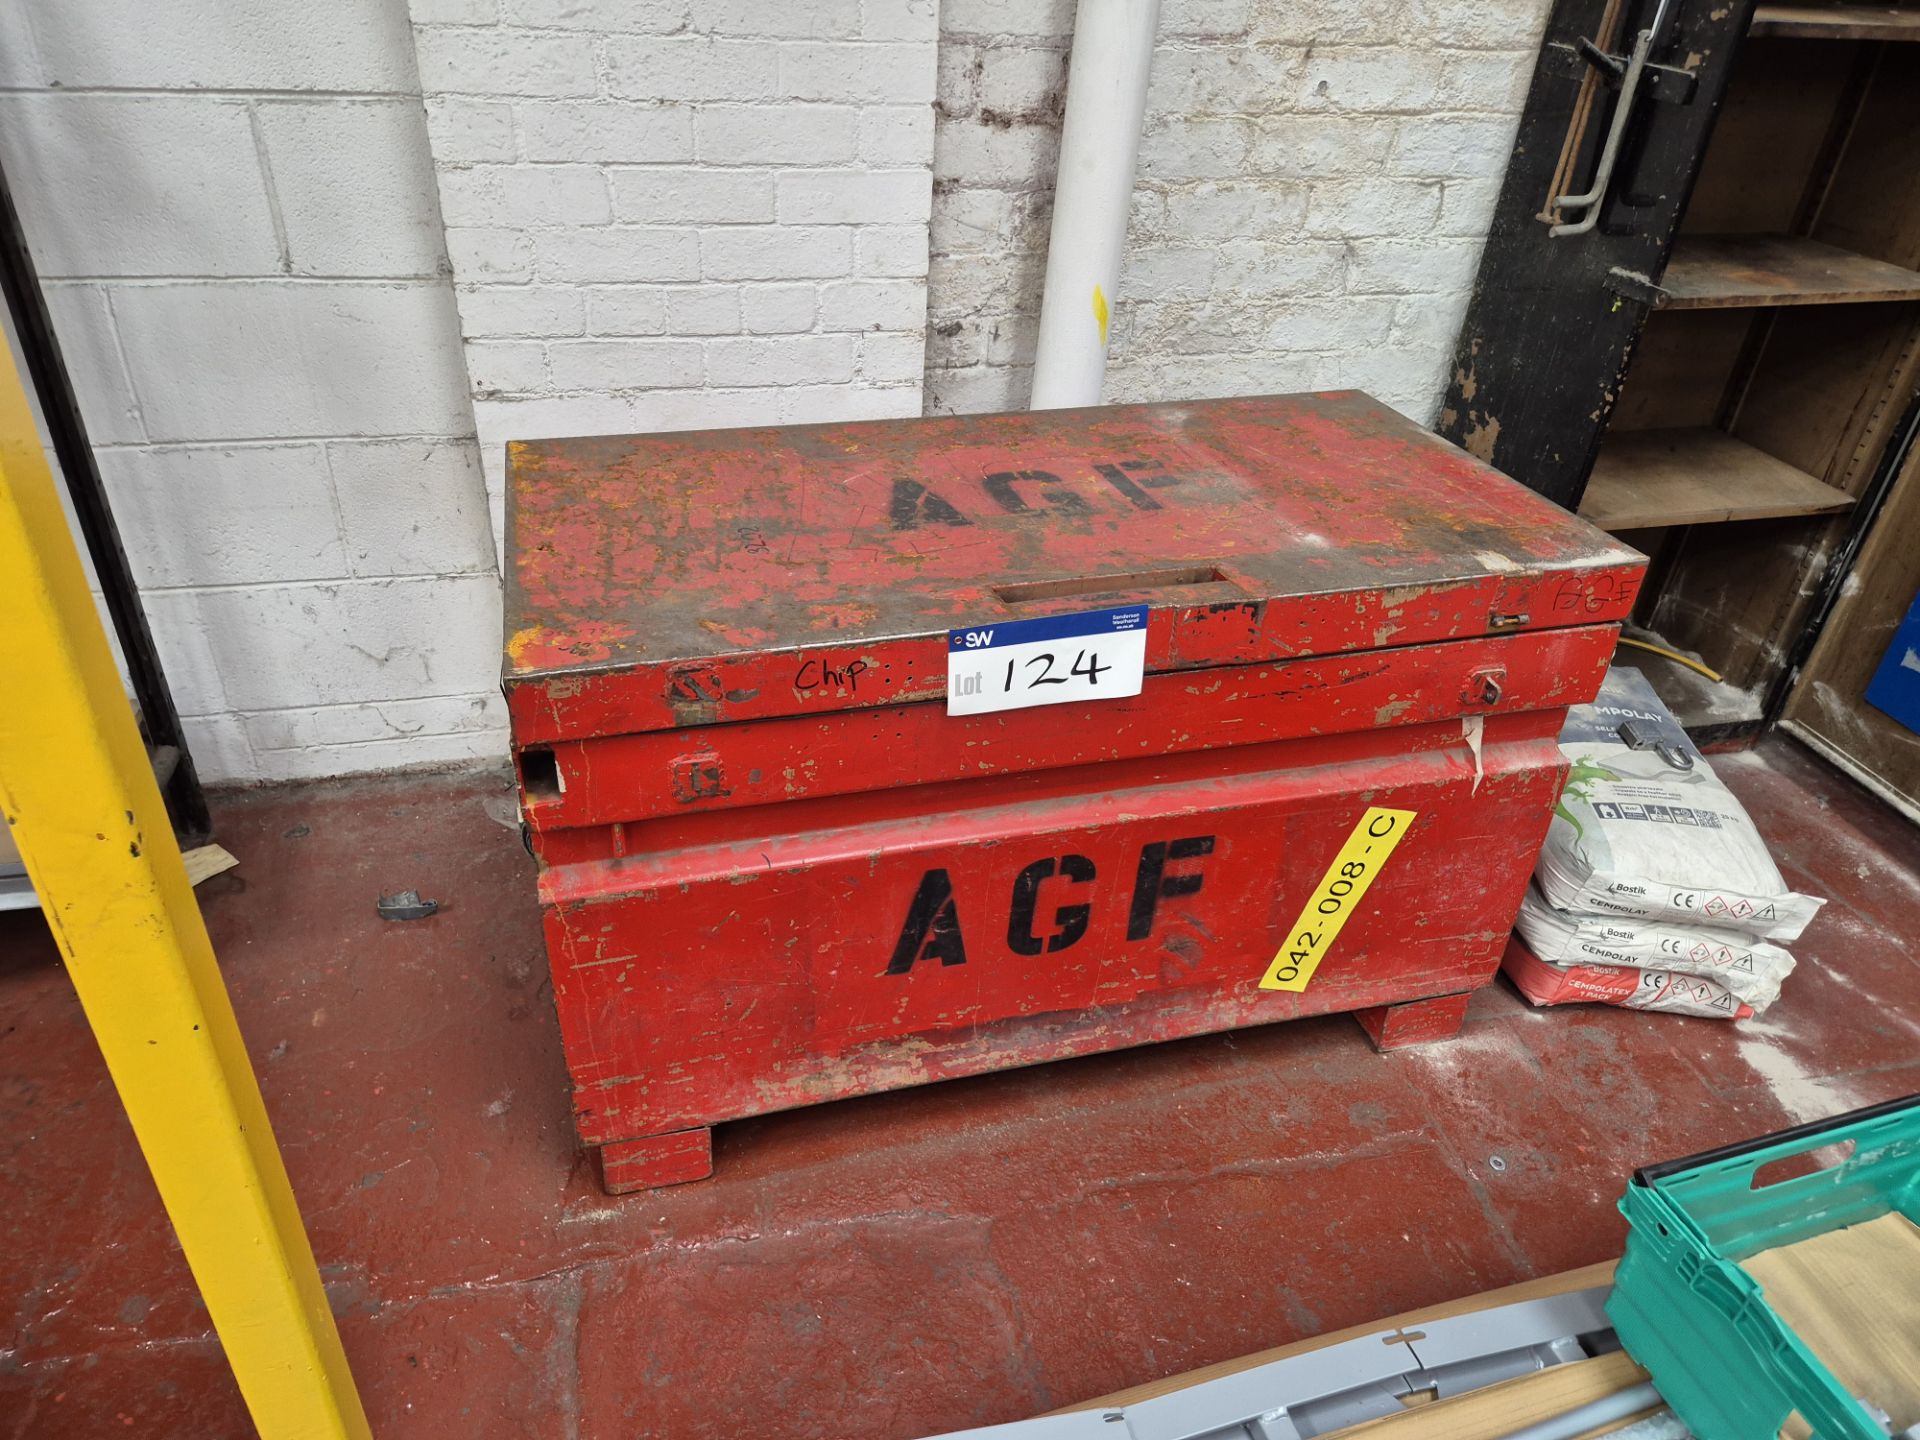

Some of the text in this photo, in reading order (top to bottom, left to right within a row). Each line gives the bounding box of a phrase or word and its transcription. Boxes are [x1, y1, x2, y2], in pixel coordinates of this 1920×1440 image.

[889, 459, 1181, 531] AGF
[965, 630, 994, 648] SW
[954, 649, 1112, 697] Lot 124
[1616, 883, 1647, 895] Bostik
[886, 835, 1216, 976] AGF
[1276, 815, 1396, 982] 042-008-C
[1590, 898, 1650, 915] CEMPOLAY
[1607, 928, 1635, 940] Bostik
[1581, 944, 1638, 963] CEMPOLAY
[1568, 979, 1632, 996] CEMPOLATEX
